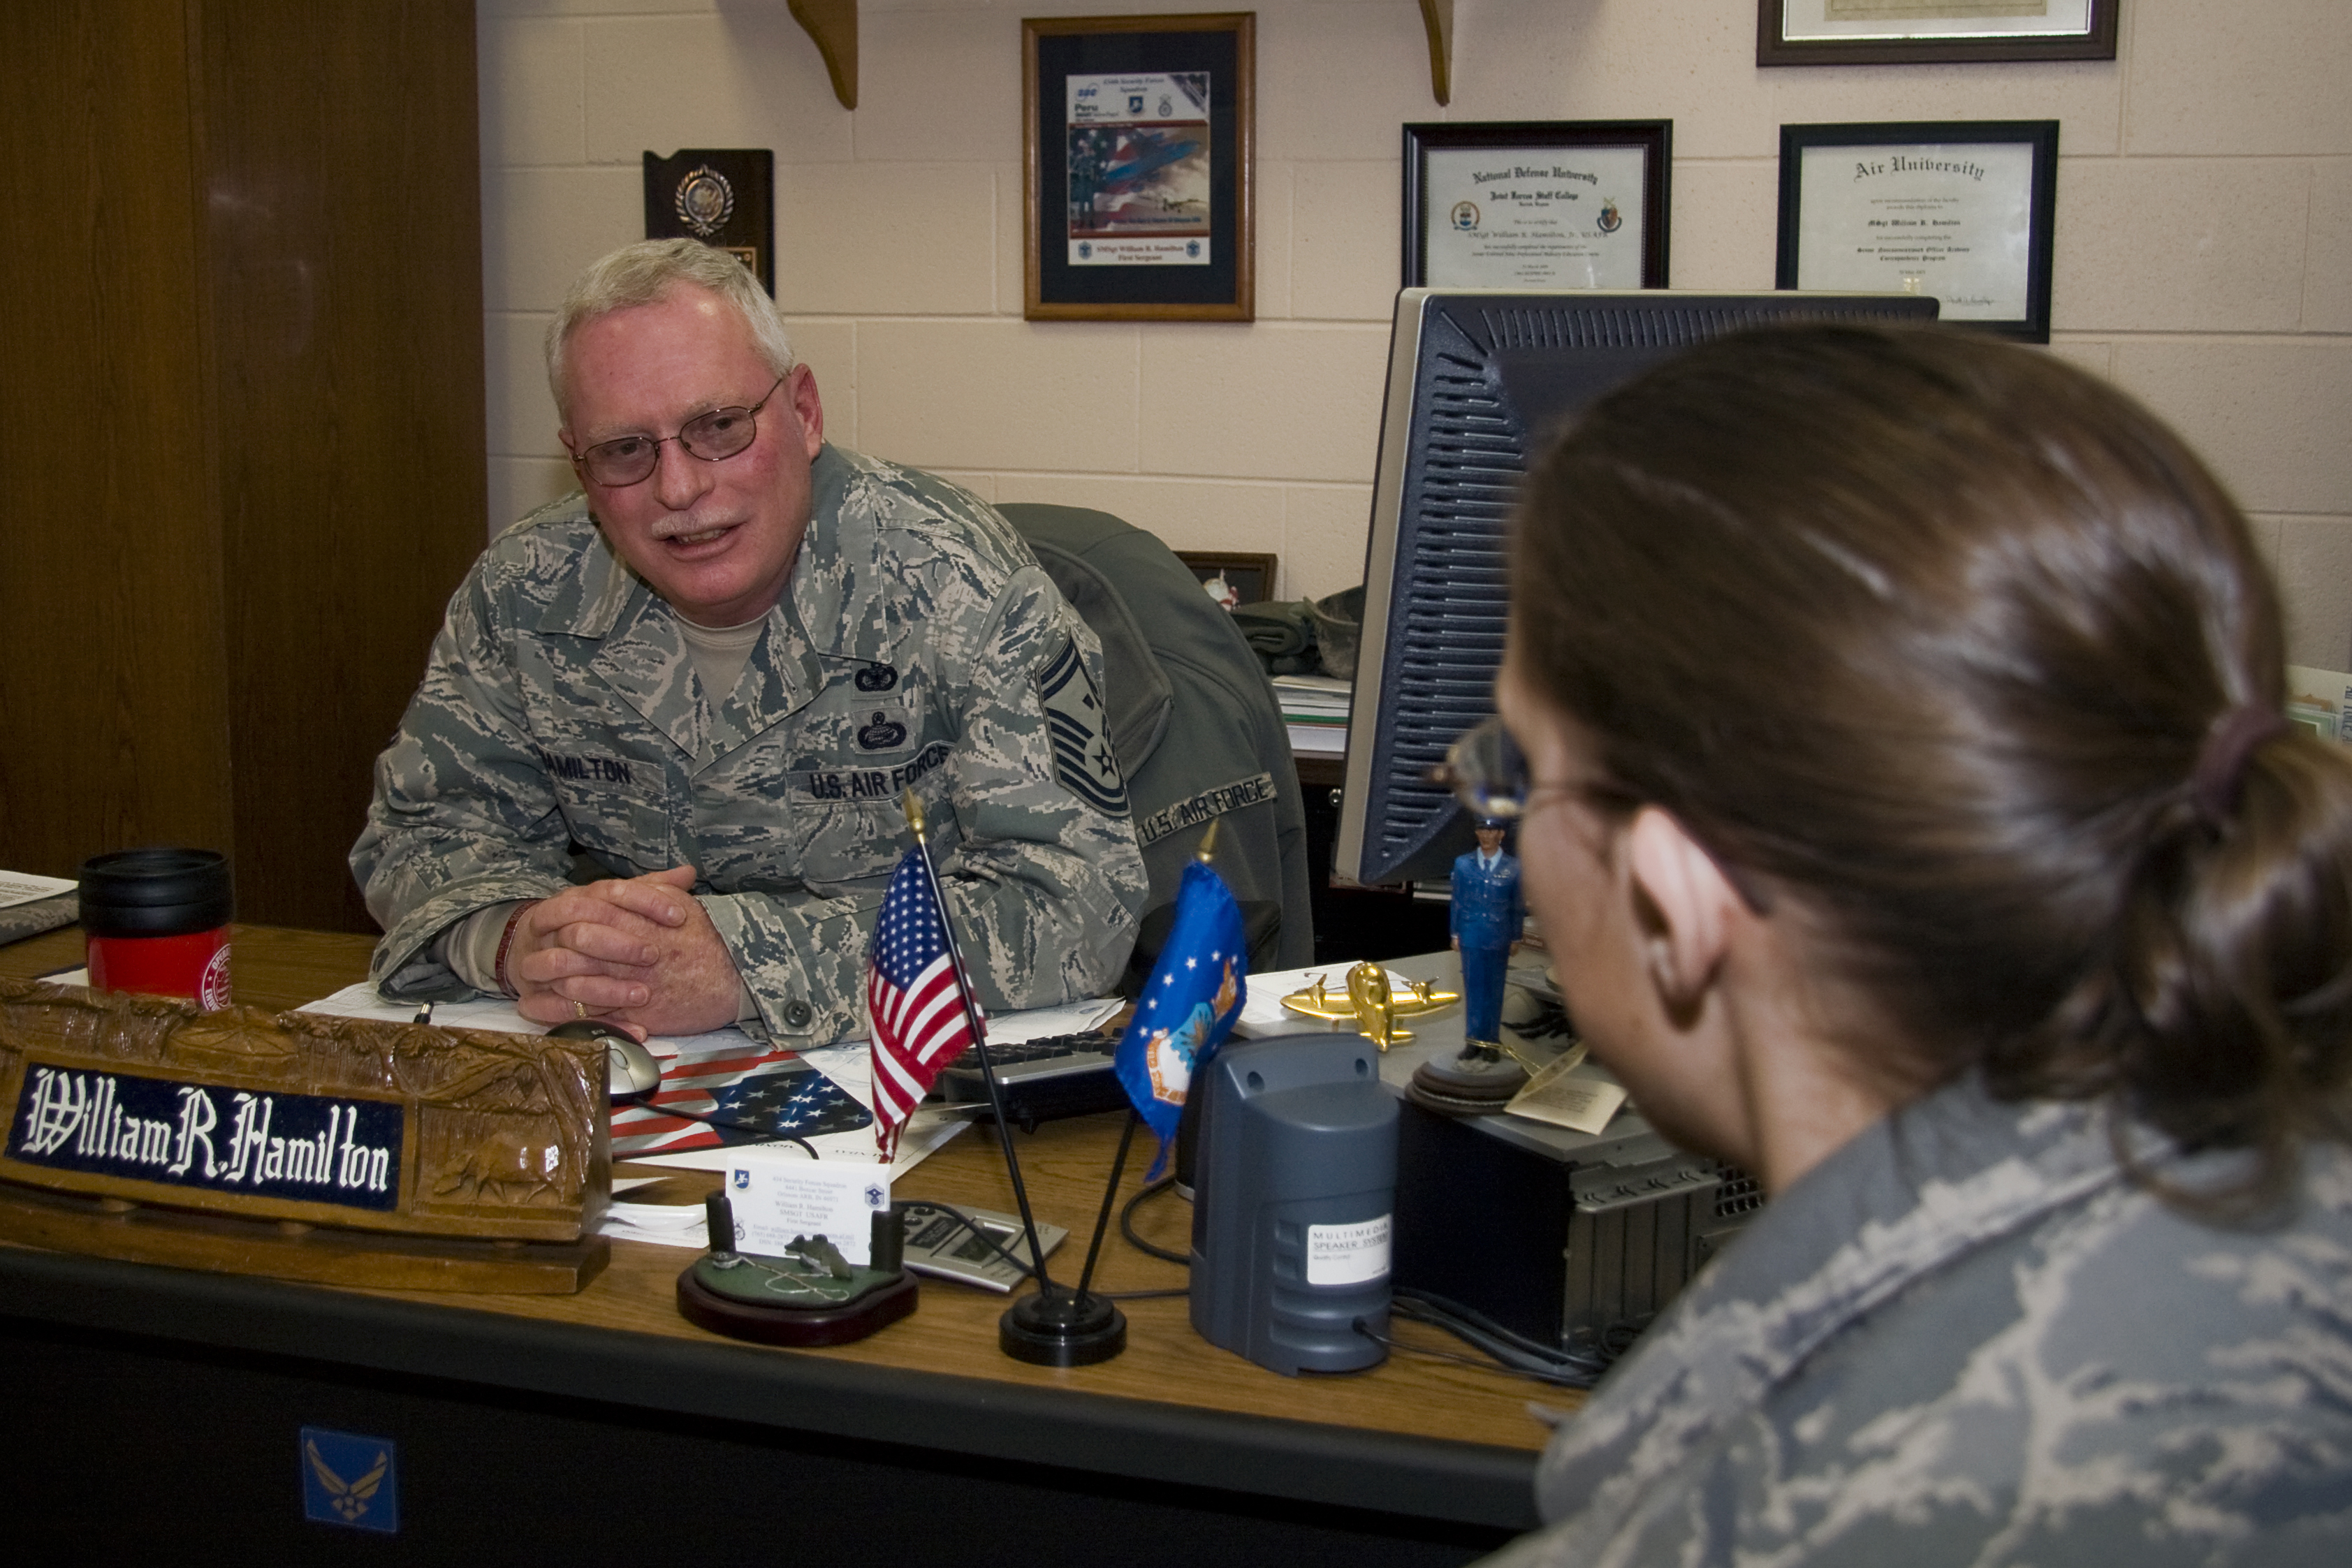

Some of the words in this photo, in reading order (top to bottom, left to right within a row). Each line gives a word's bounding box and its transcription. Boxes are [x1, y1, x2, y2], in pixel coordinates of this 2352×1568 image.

[1473, 168, 1511, 185] National
[1514, 166, 1549, 178] Defense
[1552, 166, 1598, 186] University
[1854, 161, 1885, 183] Air
[1890, 156, 1985, 182] University
[810, 773, 847, 799] U.S.
[852, 771, 890, 797] AIR
[891, 744, 950, 792] FORCE
[1141, 813, 1178, 843] U.S.
[1180, 796, 1212, 825] AIR
[1212, 777, 1269, 812] FORCE
[21, 1069, 172, 1165] William
[168, 1087, 228, 1178] R.
[225, 1092, 389, 1192] Hamilton
[775, 1201, 798, 1209] William
[807, 1204, 833, 1212] Hamilton
[1313, 1222, 1388, 1240] MULTIMEDIA
[1314, 1240, 1358, 1251] SPEAKER
